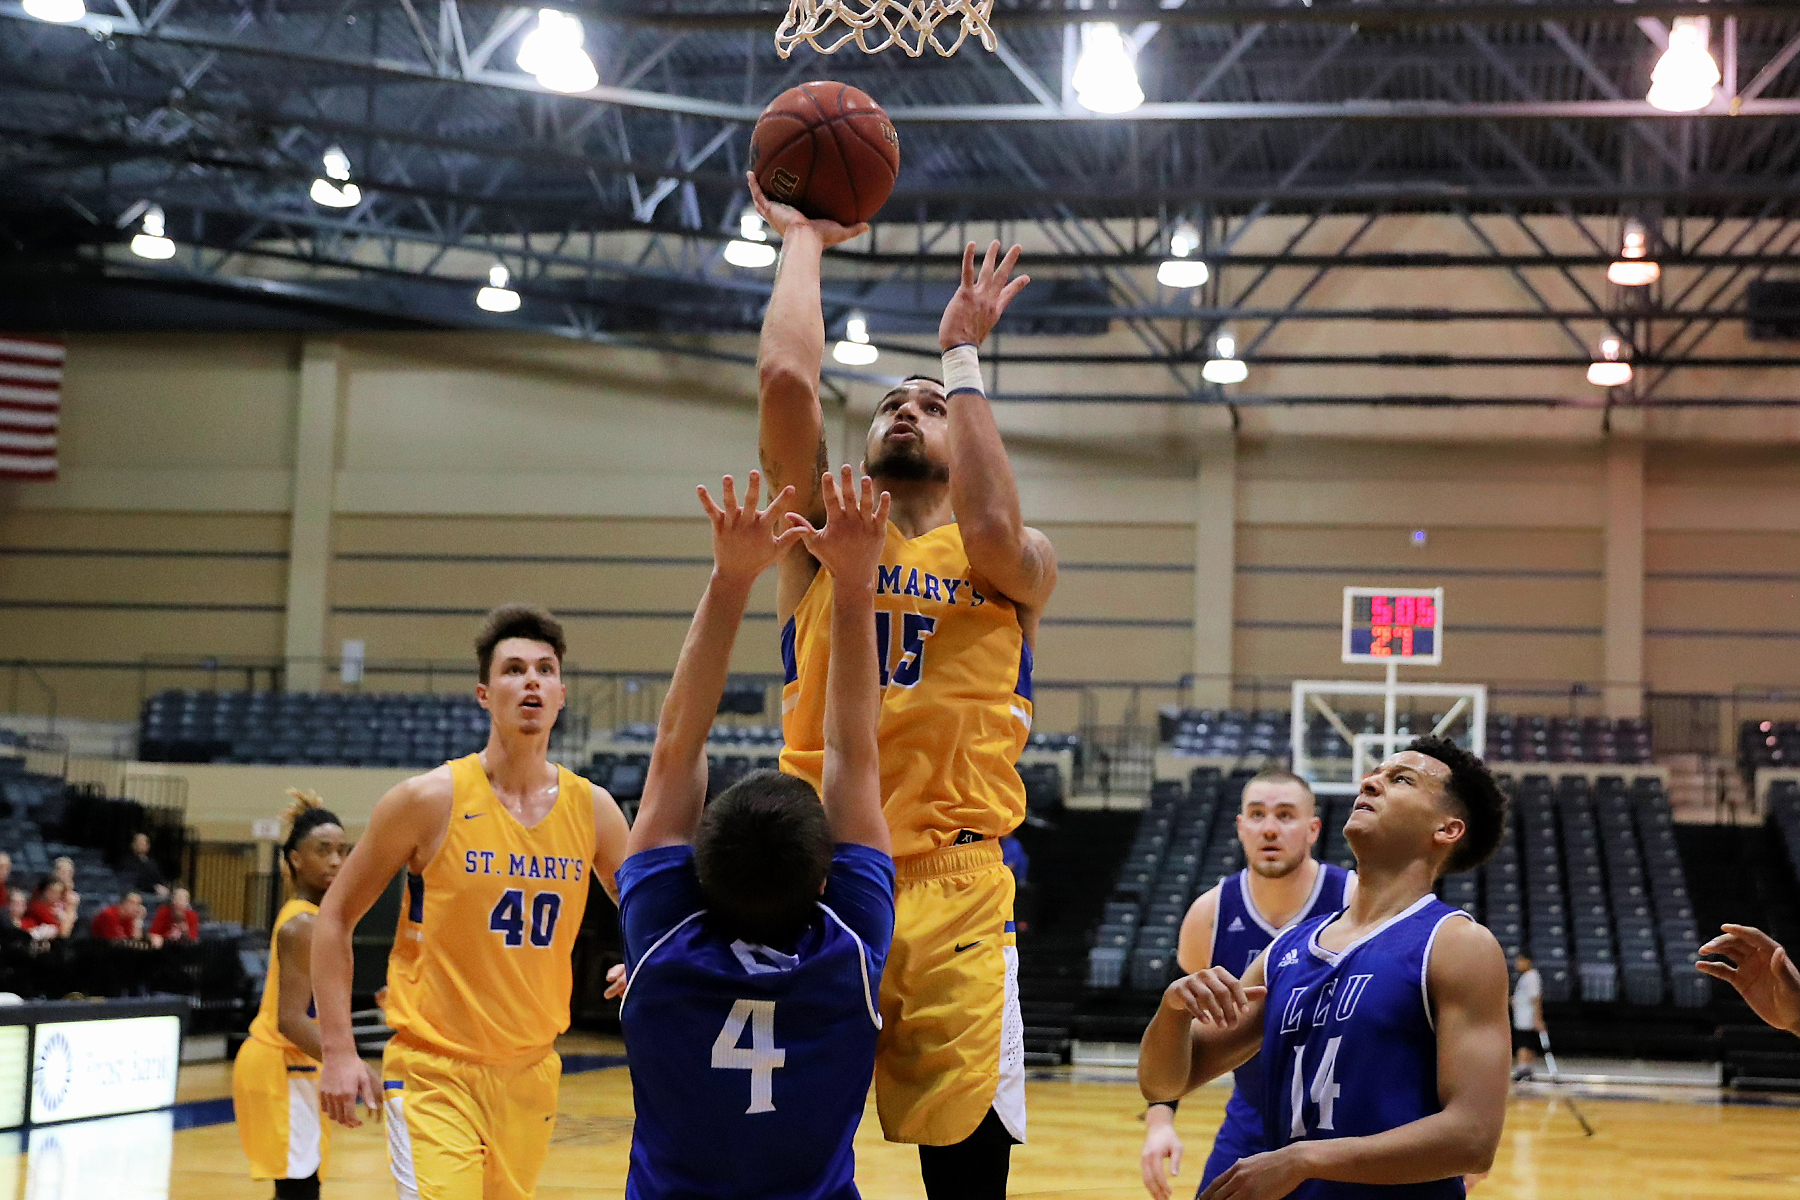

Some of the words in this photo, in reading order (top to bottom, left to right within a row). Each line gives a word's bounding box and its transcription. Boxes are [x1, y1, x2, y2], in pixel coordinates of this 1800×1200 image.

[875, 610, 938, 689] 15
[1370, 626, 1414, 658] 27
[465, 850, 500, 874] ST.
[508, 852, 583, 882] MARY'S
[488, 887, 564, 949] 40
[1279, 973, 1374, 1035] LCU
[710, 998, 787, 1115] 4
[1289, 1034, 1343, 1140] 14
